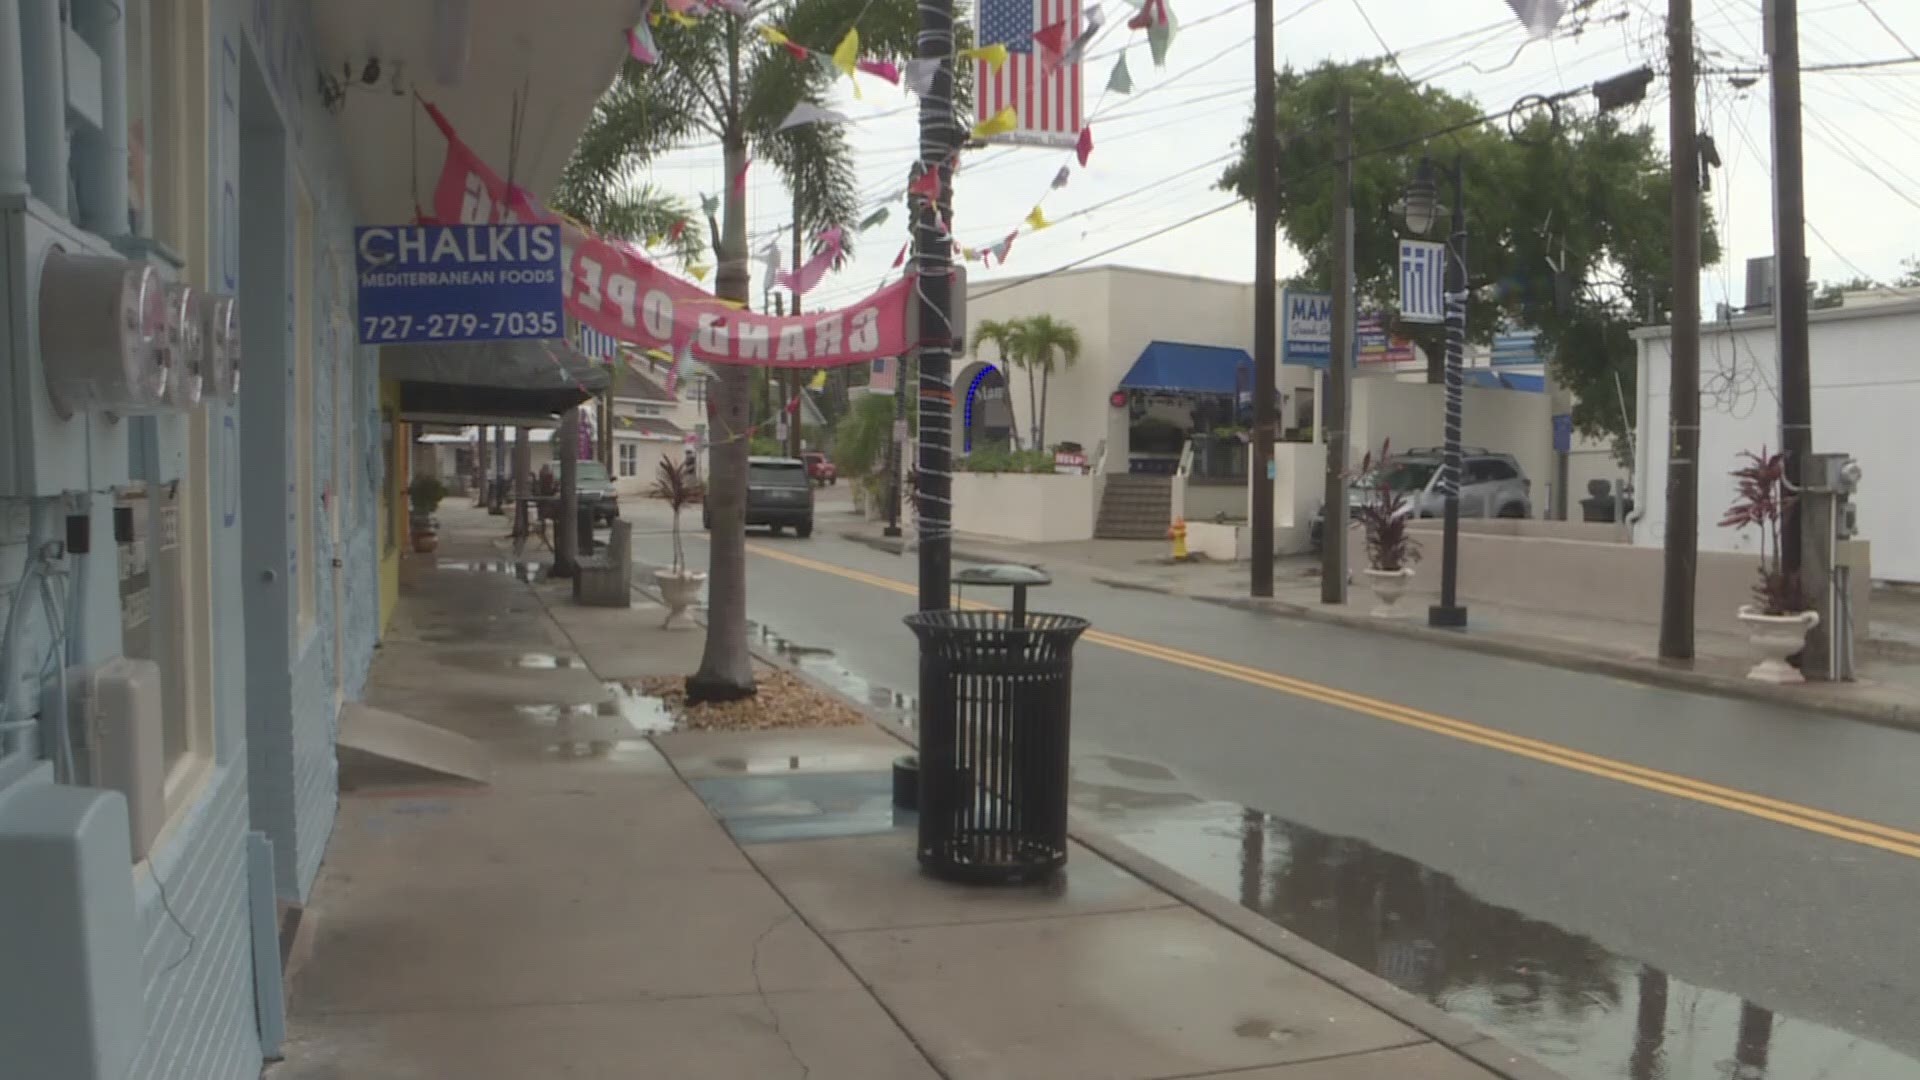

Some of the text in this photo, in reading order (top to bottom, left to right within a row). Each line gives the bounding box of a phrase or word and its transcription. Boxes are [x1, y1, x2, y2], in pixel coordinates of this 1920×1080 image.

[359, 226, 555, 265] CHALKIS
[362, 269, 555, 287] MEDITERRANEAN FOODS
[363, 312, 557, 340] 727-279-7035
